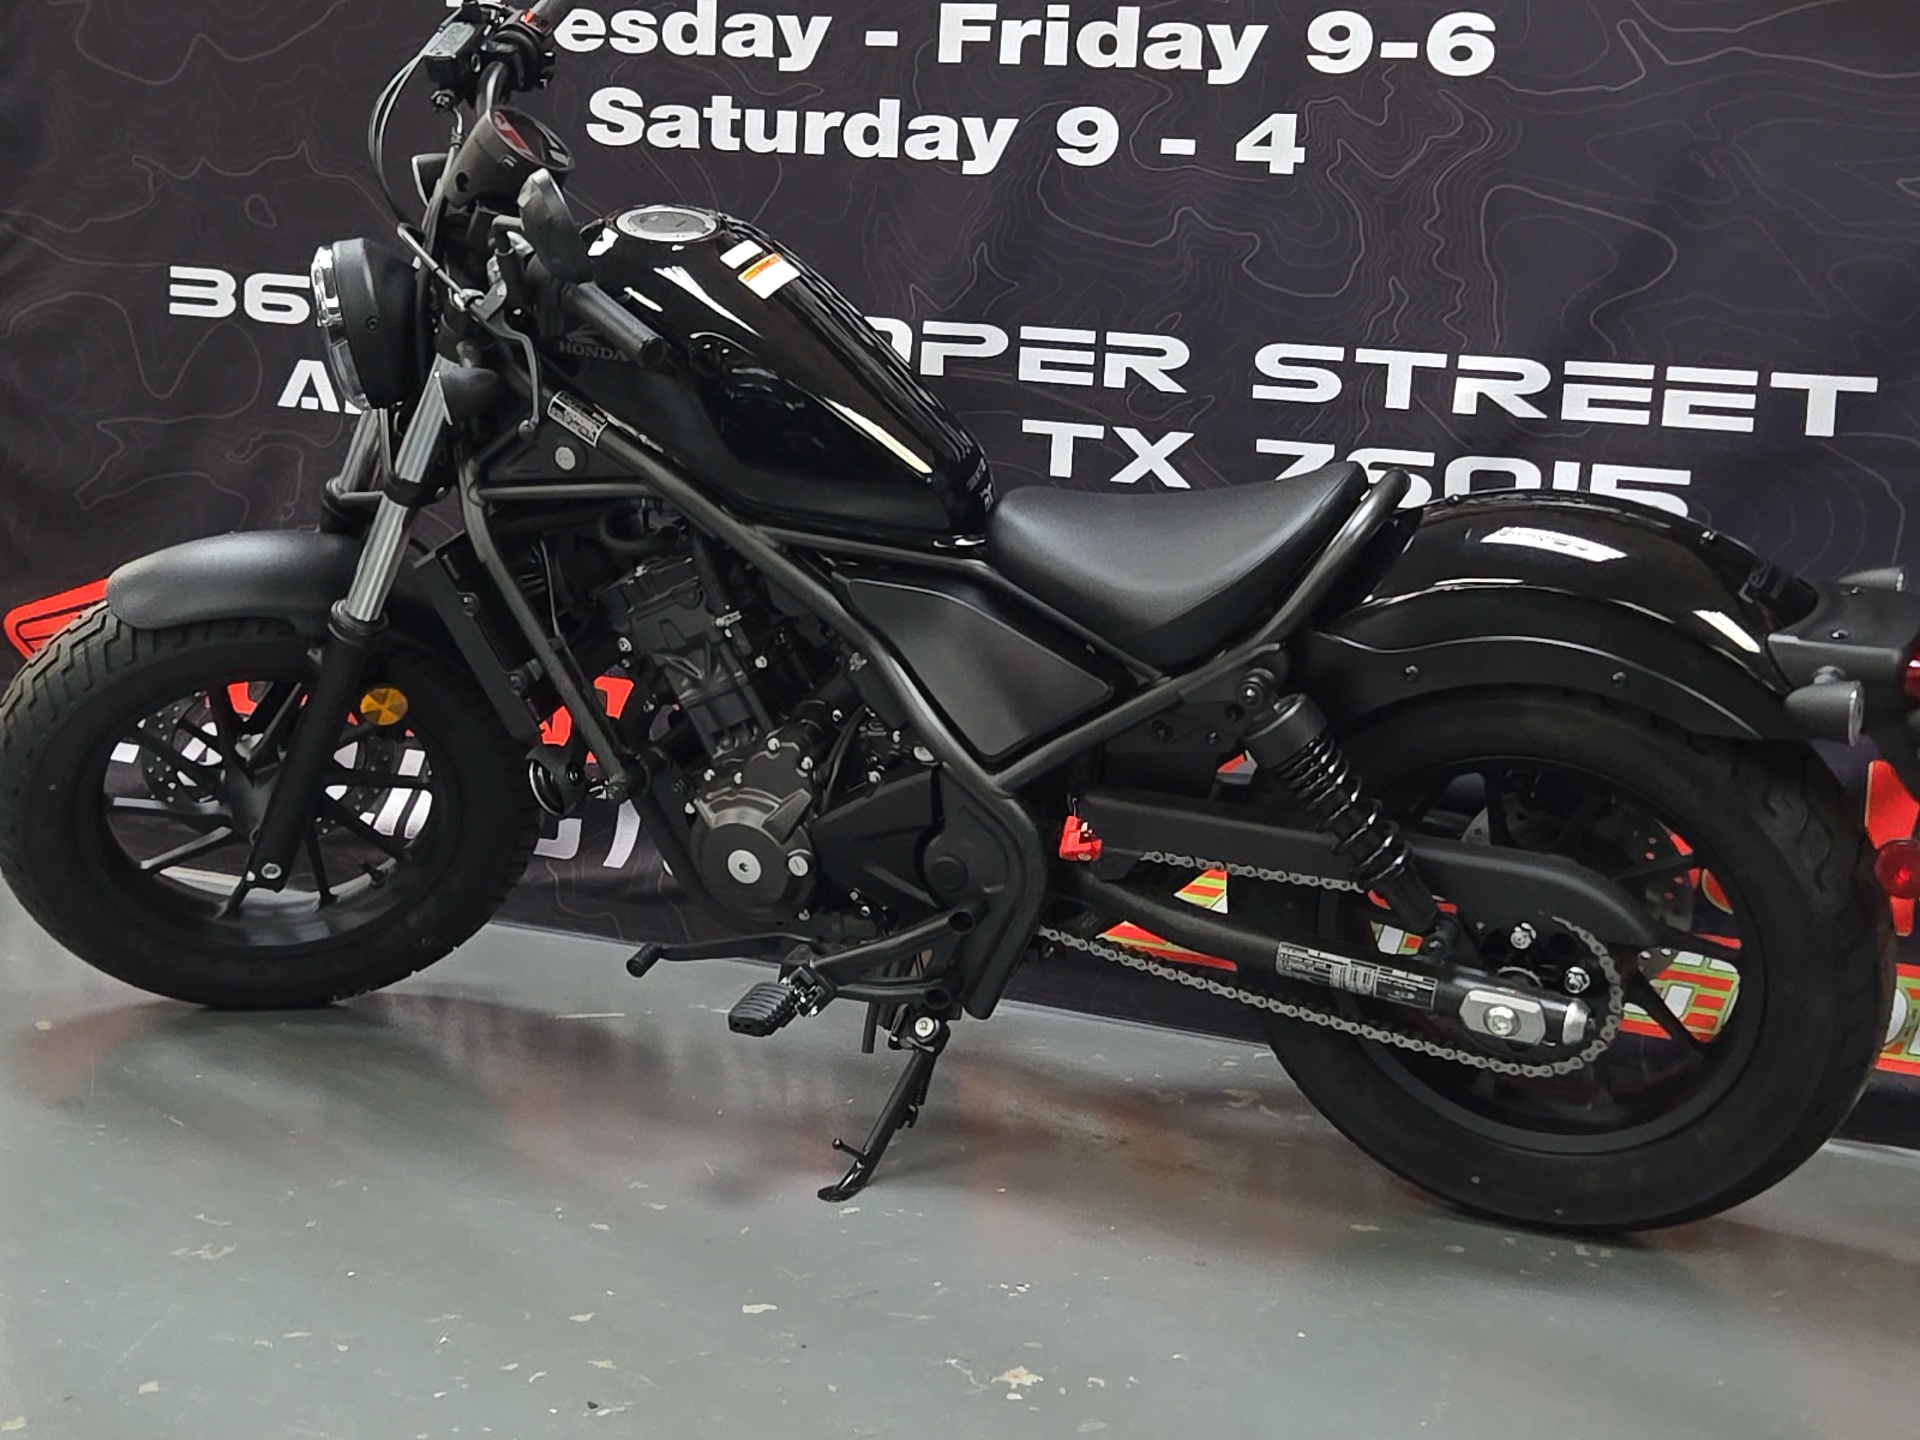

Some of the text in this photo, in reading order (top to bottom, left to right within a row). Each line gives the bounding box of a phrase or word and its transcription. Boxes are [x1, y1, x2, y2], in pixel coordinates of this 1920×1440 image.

[865, 31, 898, 46] -
[938, 3, 1268, 84] Friday
[1307, 11, 1495, 76] 9-6
[587, 87, 1305, 174] Saturday 9 - 4
[557, 340, 629, 362] HONDA
[1252, 343, 1878, 437] STREET
[1022, 419, 1194, 488] TX
